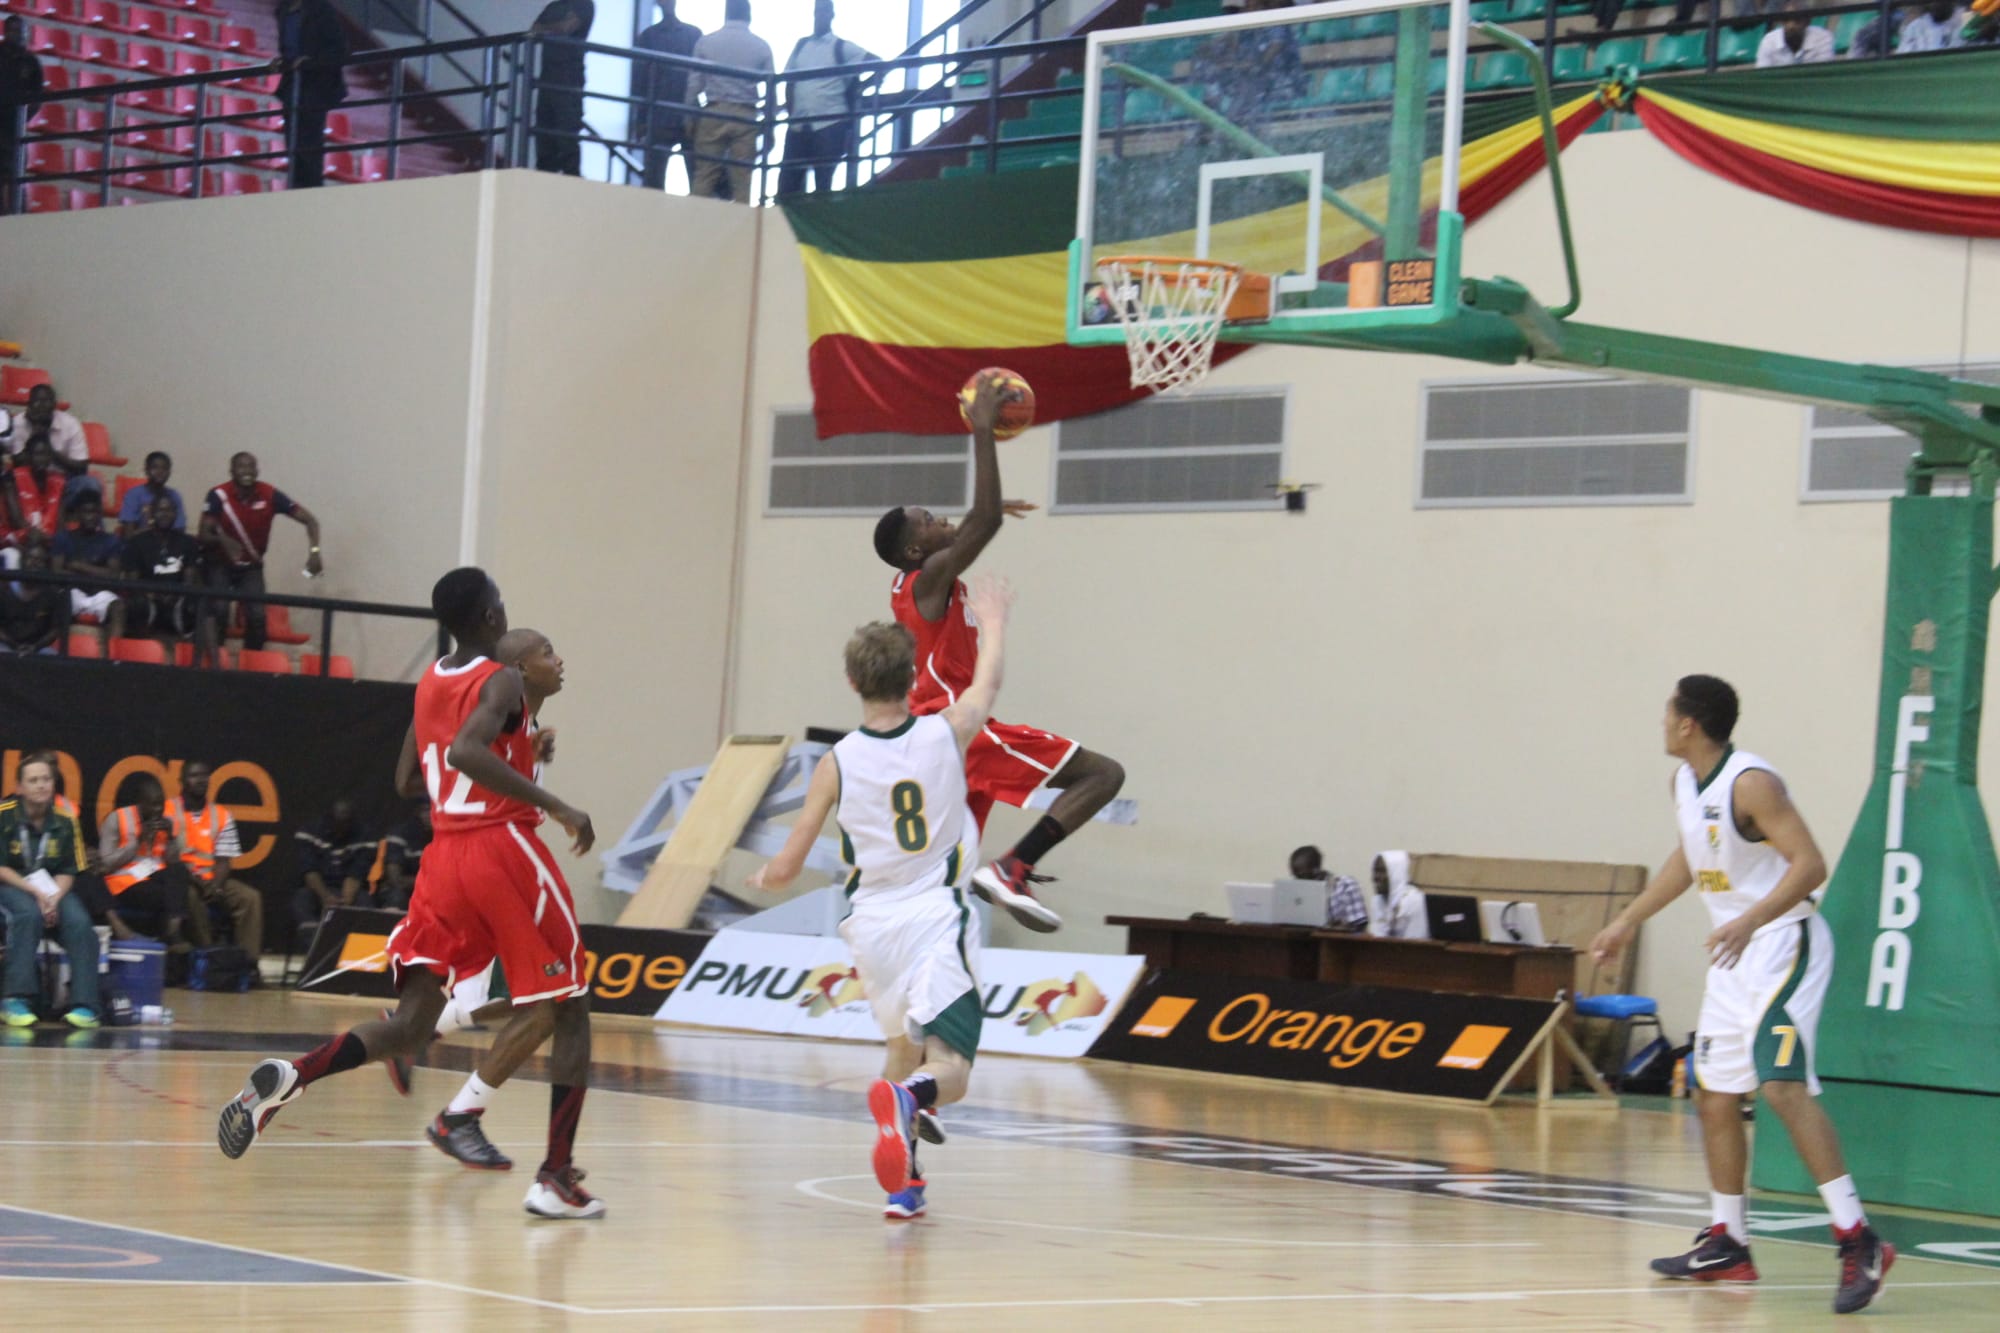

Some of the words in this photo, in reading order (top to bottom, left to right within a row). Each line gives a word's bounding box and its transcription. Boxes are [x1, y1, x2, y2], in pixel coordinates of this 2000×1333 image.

[1389, 261, 1434, 282] CLEAN
[1387, 281, 1433, 305] GAME
[422, 742, 486, 814] 12
[891, 779, 929, 854] 8
[1865, 696, 1935, 1011] FIBA
[684, 960, 814, 1000] PMU
[983, 984, 1028, 1019] U
[1208, 993, 1426, 1069] Orange
[1771, 1025, 1797, 1067] 7
